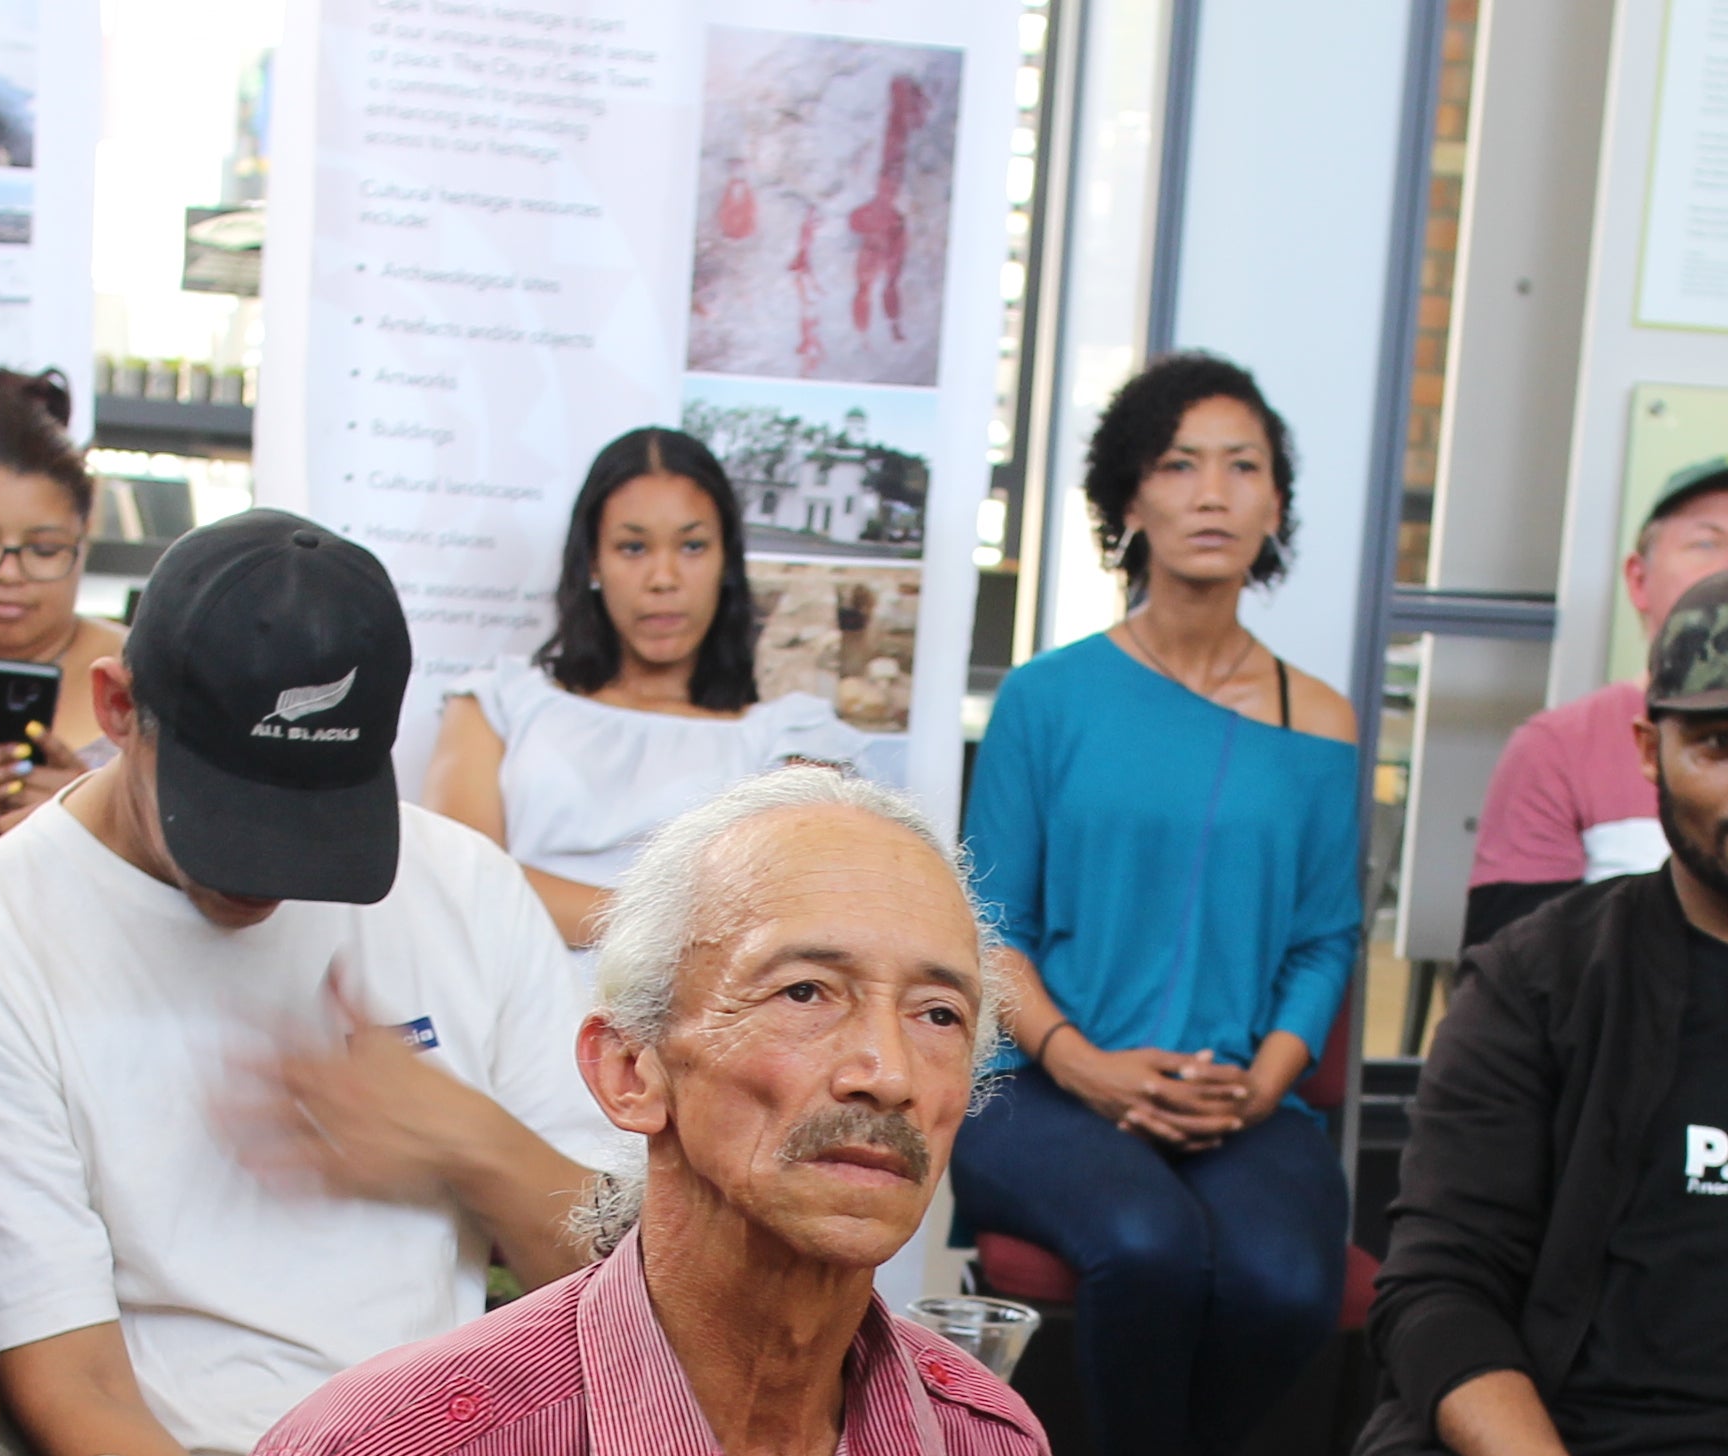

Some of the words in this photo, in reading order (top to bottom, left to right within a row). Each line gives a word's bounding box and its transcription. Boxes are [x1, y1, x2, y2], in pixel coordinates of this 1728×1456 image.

[493, 8, 564, 31] heritage
[569, 44, 602, 58] and
[491, 56, 525, 80] City
[554, 63, 600, 85] Cape
[466, 112, 501, 128] and
[359, 178, 435, 203] Cultural
[438, 187, 514, 214] heritage
[518, 198, 604, 218] resources
[381, 262, 519, 294] Archaeological
[522, 275, 563, 294] sites
[378, 314, 463, 337] Artefacts
[529, 329, 596, 350] objects
[374, 367, 458, 391] Artworks
[371, 418, 456, 447] Buildings
[368, 469, 440, 494] Cultural
[444, 478, 544, 503] landscapes
[367, 519, 434, 546] Historic
[437, 531, 497, 551] places
[250, 723, 284, 738] ALL
[287, 727, 360, 742] BLACKS
